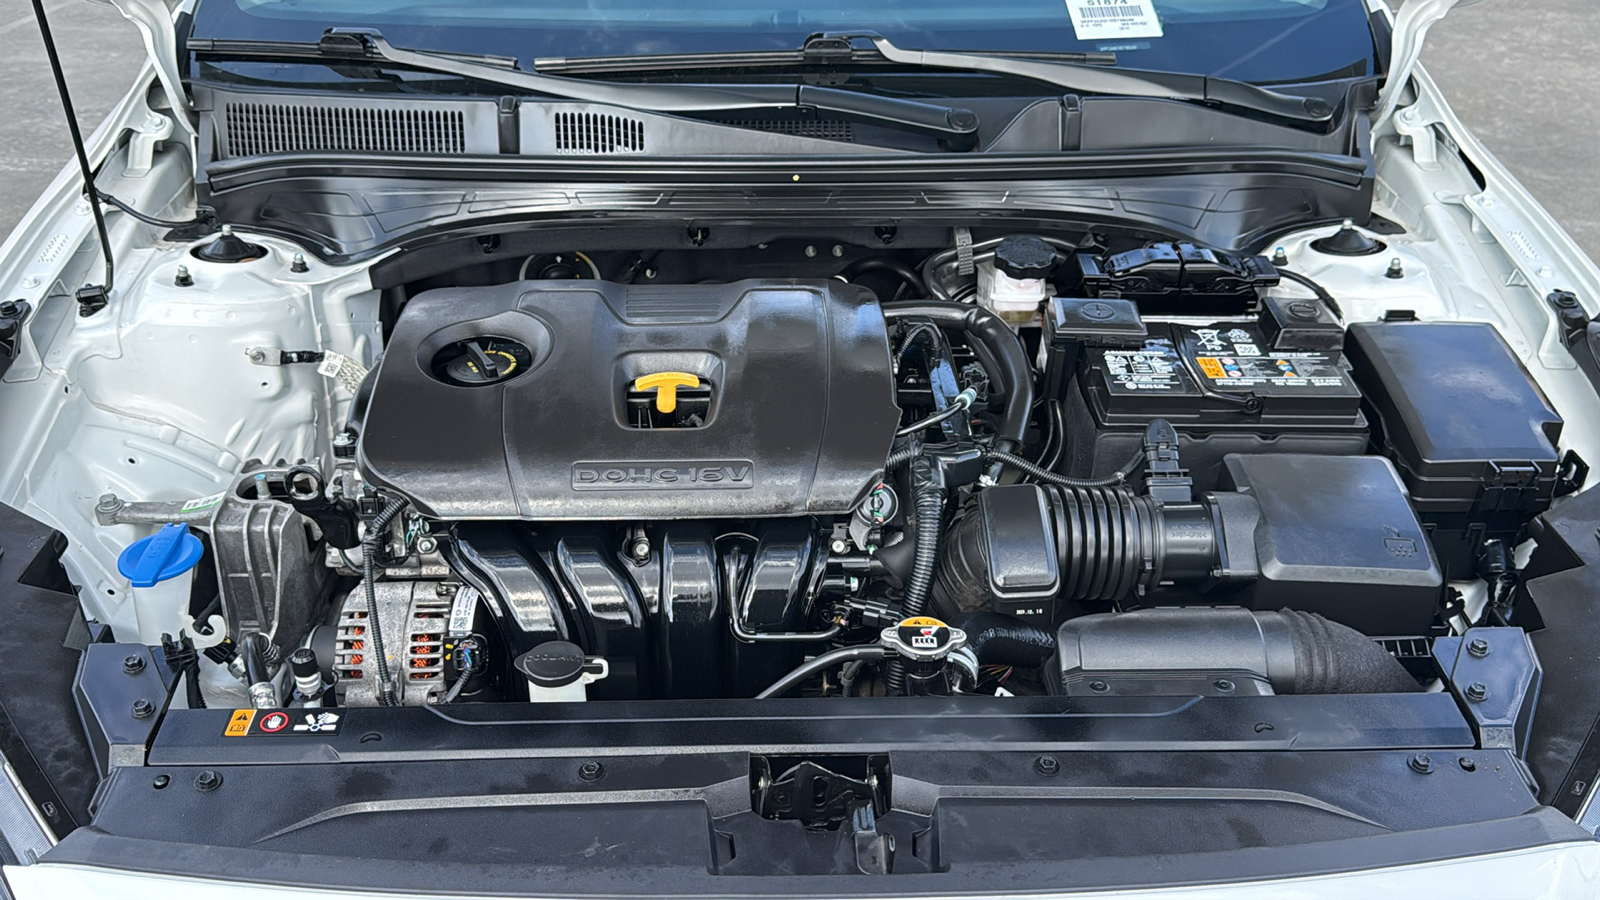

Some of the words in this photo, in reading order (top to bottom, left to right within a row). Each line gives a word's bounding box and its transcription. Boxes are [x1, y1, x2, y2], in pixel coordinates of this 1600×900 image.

[574, 468, 679, 483] DOHC
[689, 466, 750, 482] 16V
[526, 653, 583, 663] COOLANT
